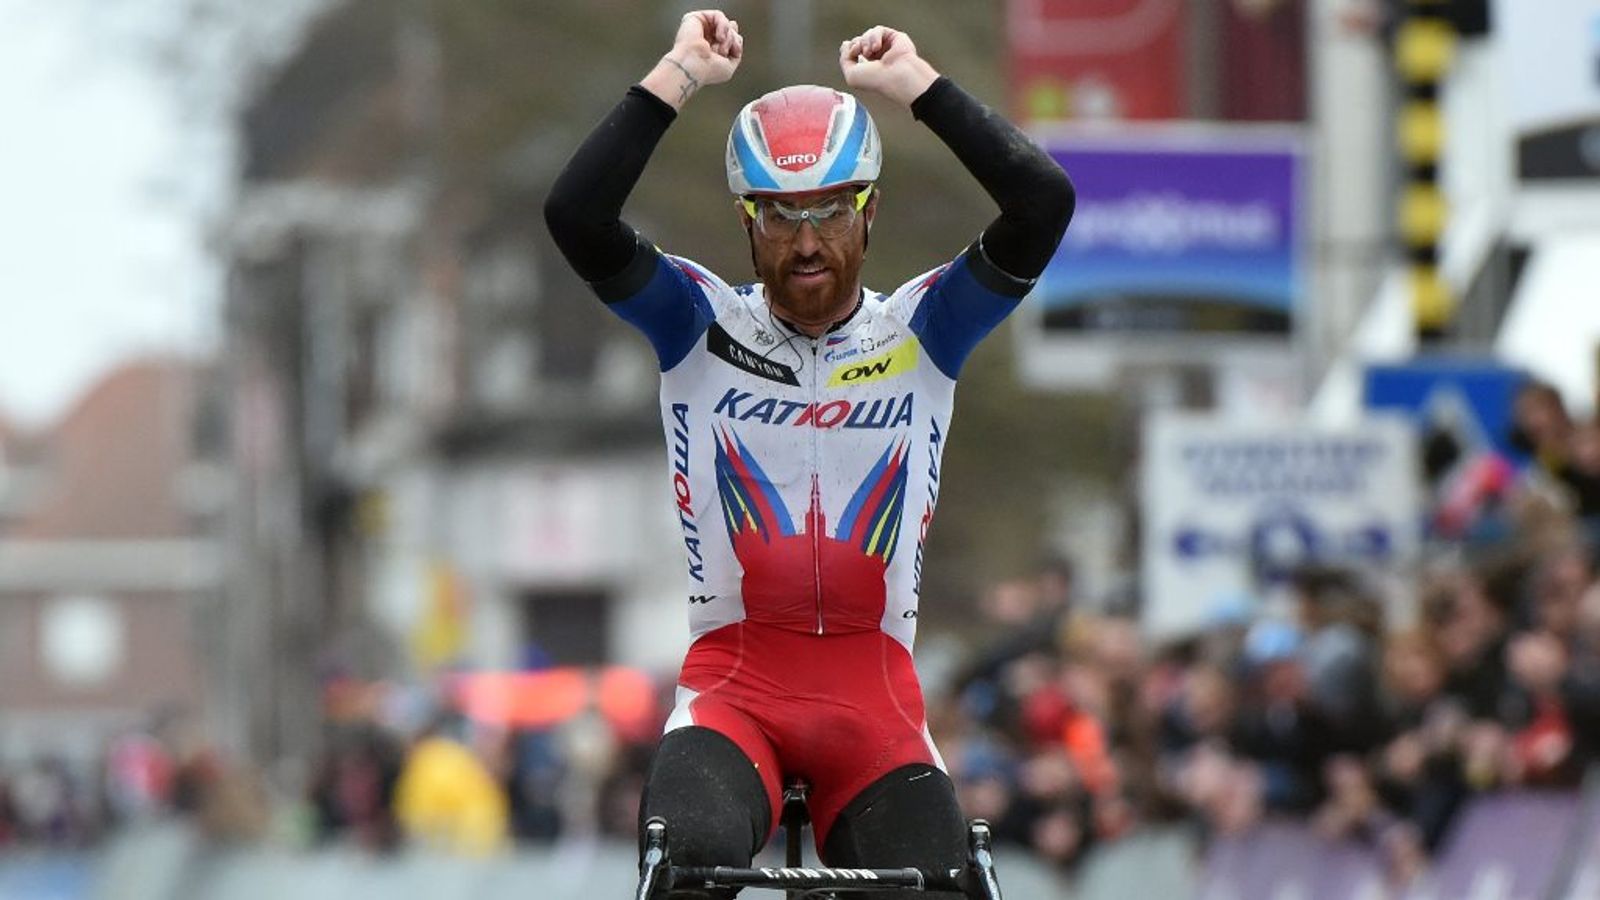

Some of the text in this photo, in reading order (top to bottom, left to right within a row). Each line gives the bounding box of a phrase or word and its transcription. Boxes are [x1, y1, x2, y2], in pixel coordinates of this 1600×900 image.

[776, 154, 817, 166] GIRO
[729, 343, 785, 379] CANYON
[841, 357, 892, 381] OW
[714, 388, 914, 428] КАТЮША
[673, 403, 704, 582] КАТЮША
[760, 867, 878, 879] CANYON
